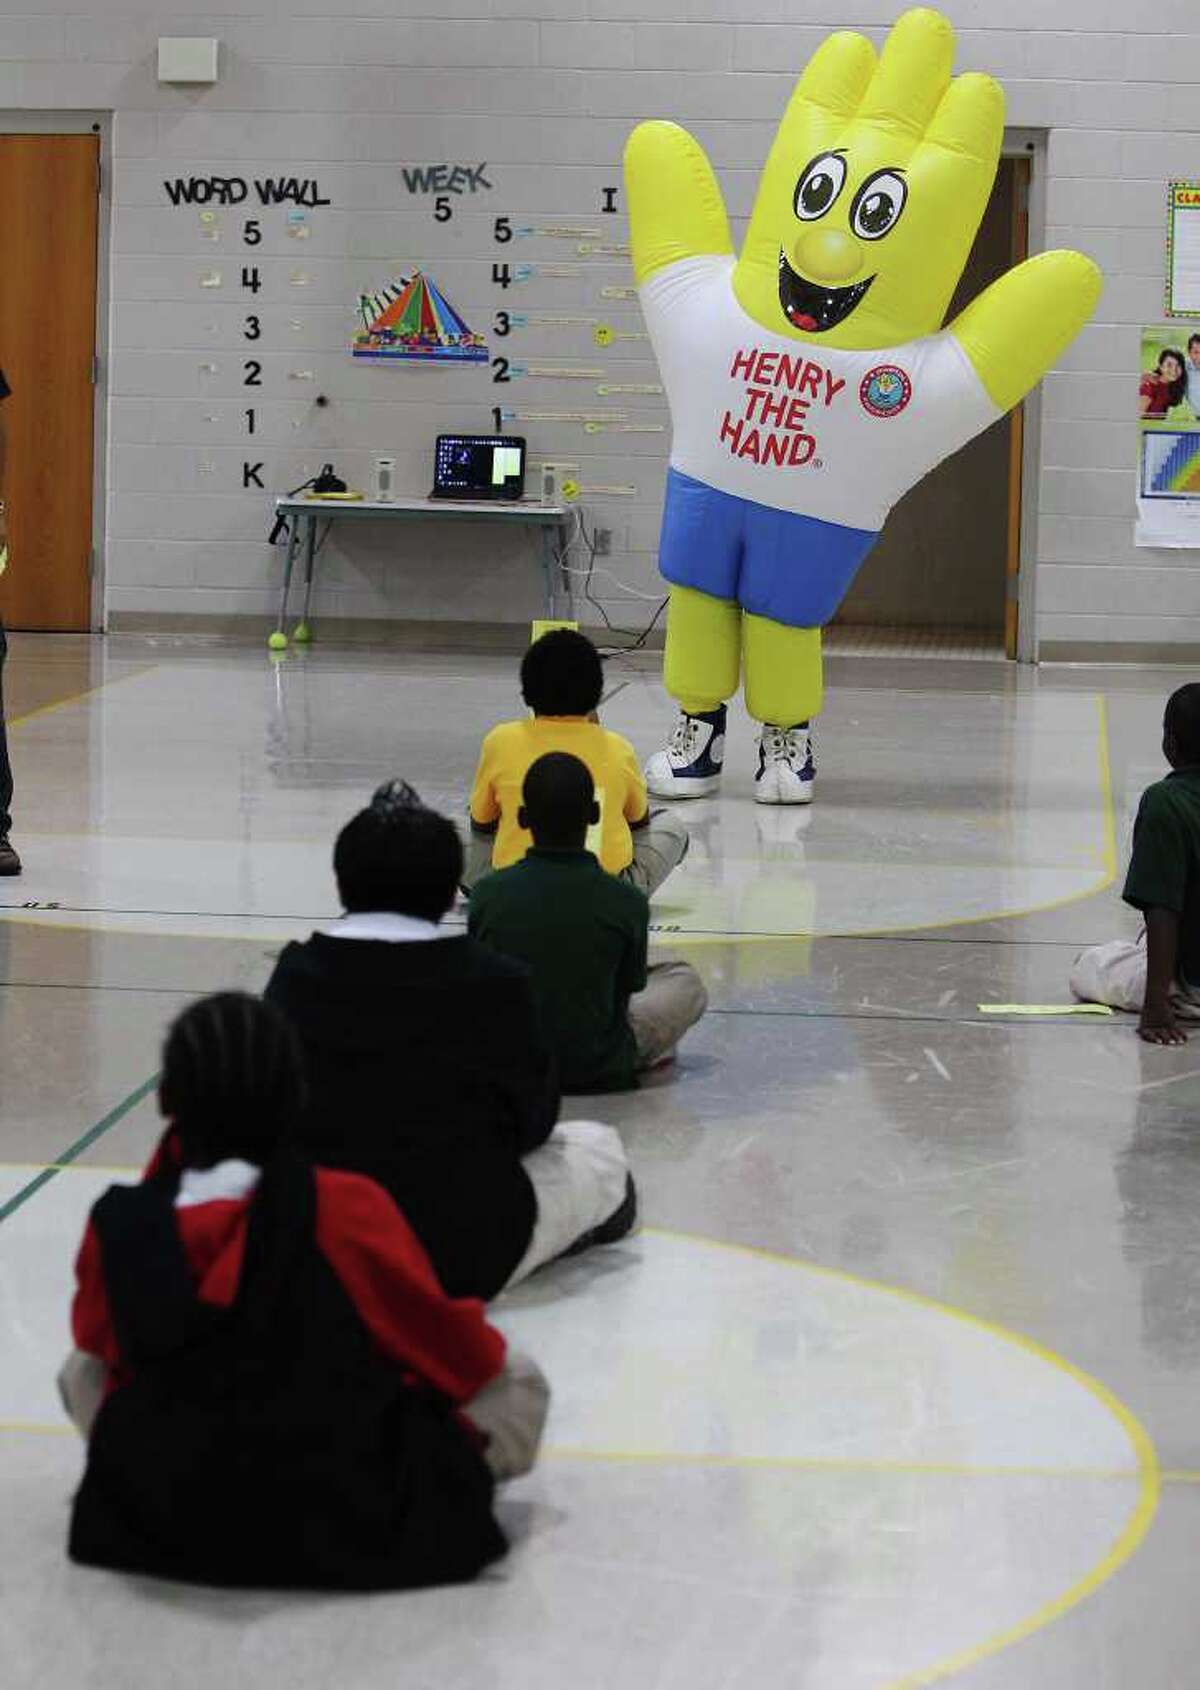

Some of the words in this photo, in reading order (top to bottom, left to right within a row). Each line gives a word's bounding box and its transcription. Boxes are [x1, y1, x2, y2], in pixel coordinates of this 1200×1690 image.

[164, 177, 248, 206] WORD
[254, 178, 331, 207] WALL
[402, 162, 492, 196] WEEK
[434, 197, 453, 223] 5
[243, 220, 262, 246] 5
[494, 217, 513, 244] 5
[241, 267, 262, 294] 4
[491, 263, 512, 290] 4
[244, 316, 261, 341] 3
[493, 312, 511, 337] 3
[244, 360, 262, 386] 2
[492, 357, 511, 384] 2
[730, 349, 846, 406] HENRY
[244, 408, 255, 435] 1
[491, 406, 502, 433] 1
[745, 387, 811, 432] THE
[719, 411, 818, 467] HAND
[243, 462, 265, 489] K
